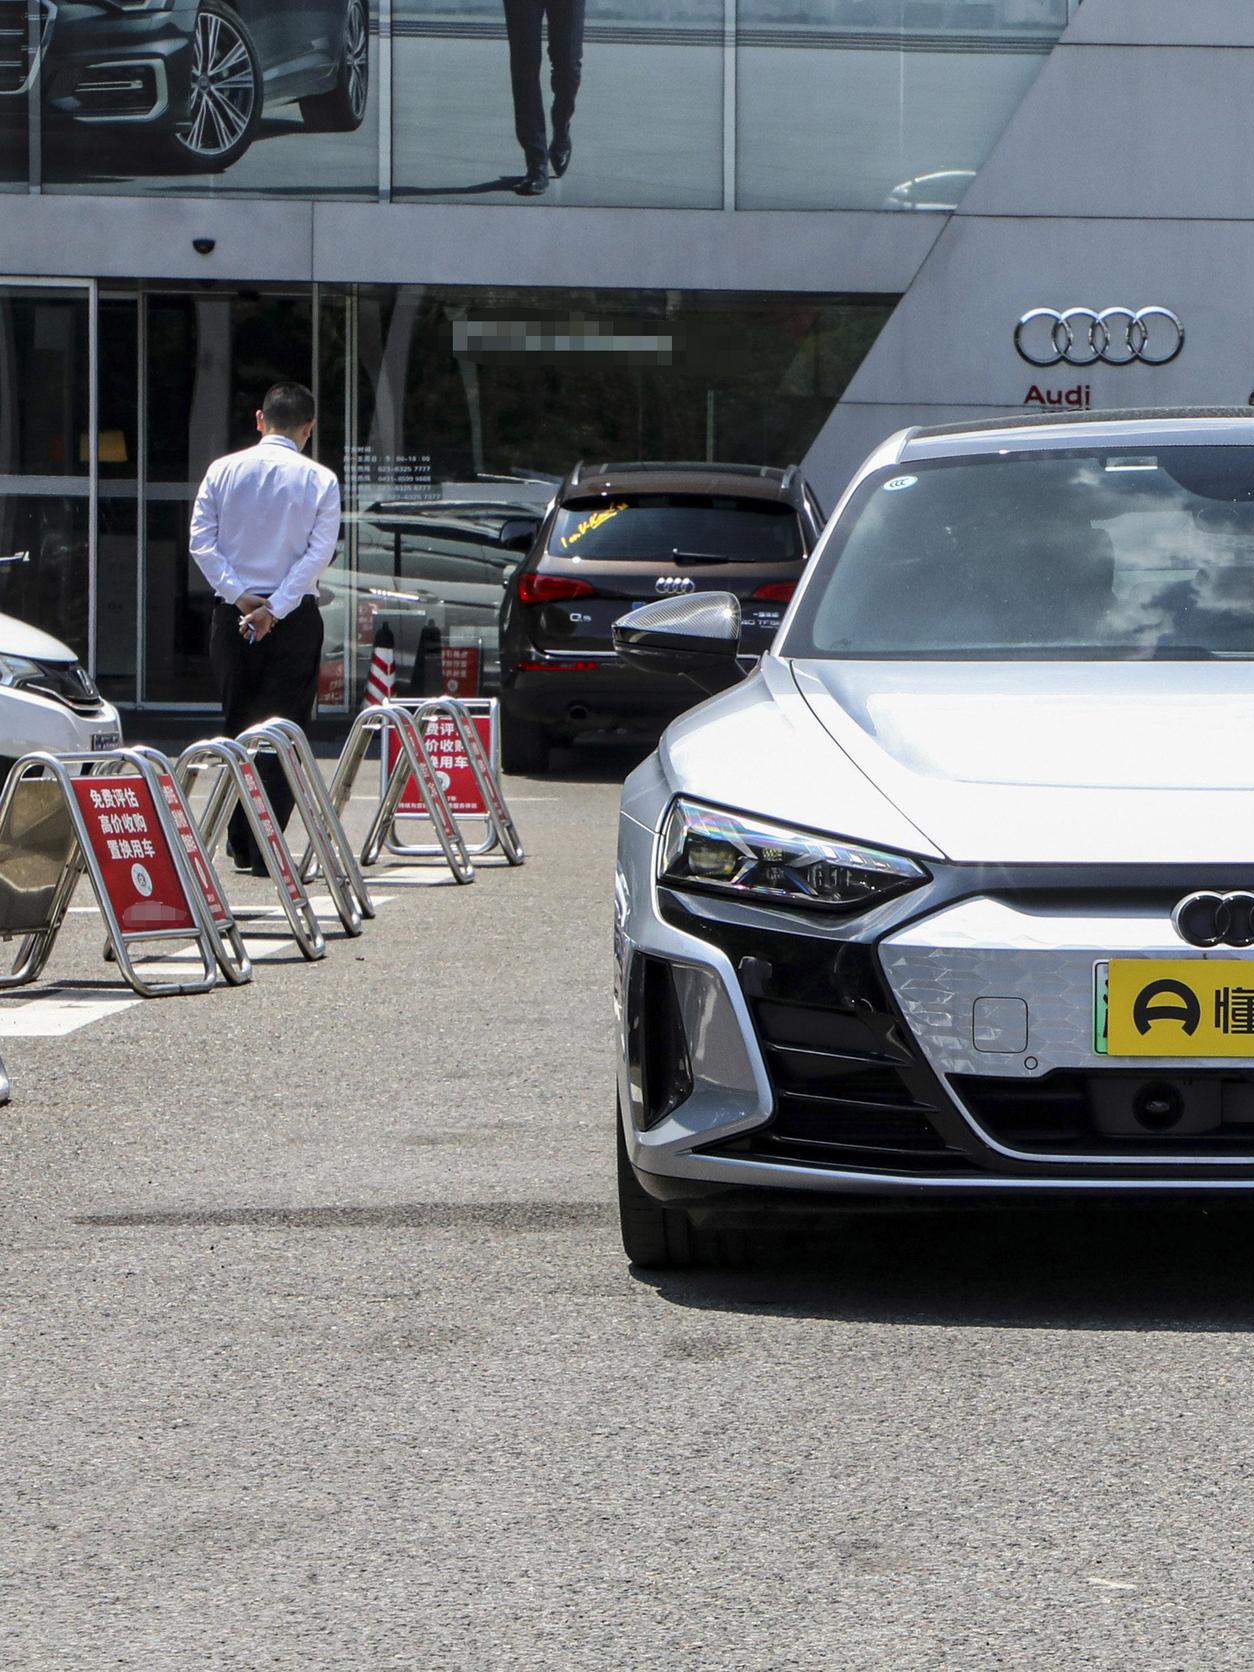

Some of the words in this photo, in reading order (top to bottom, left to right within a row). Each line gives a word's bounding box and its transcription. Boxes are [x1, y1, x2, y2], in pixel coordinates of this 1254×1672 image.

[1024, 385, 1090, 405] Audi
[569, 612, 592, 624] Q5
[425, 723, 460, 736] 费评
[89, 787, 139, 809] 免费评估
[98, 813, 148, 835] 高价收购
[106, 838, 156, 860] 置换用车
